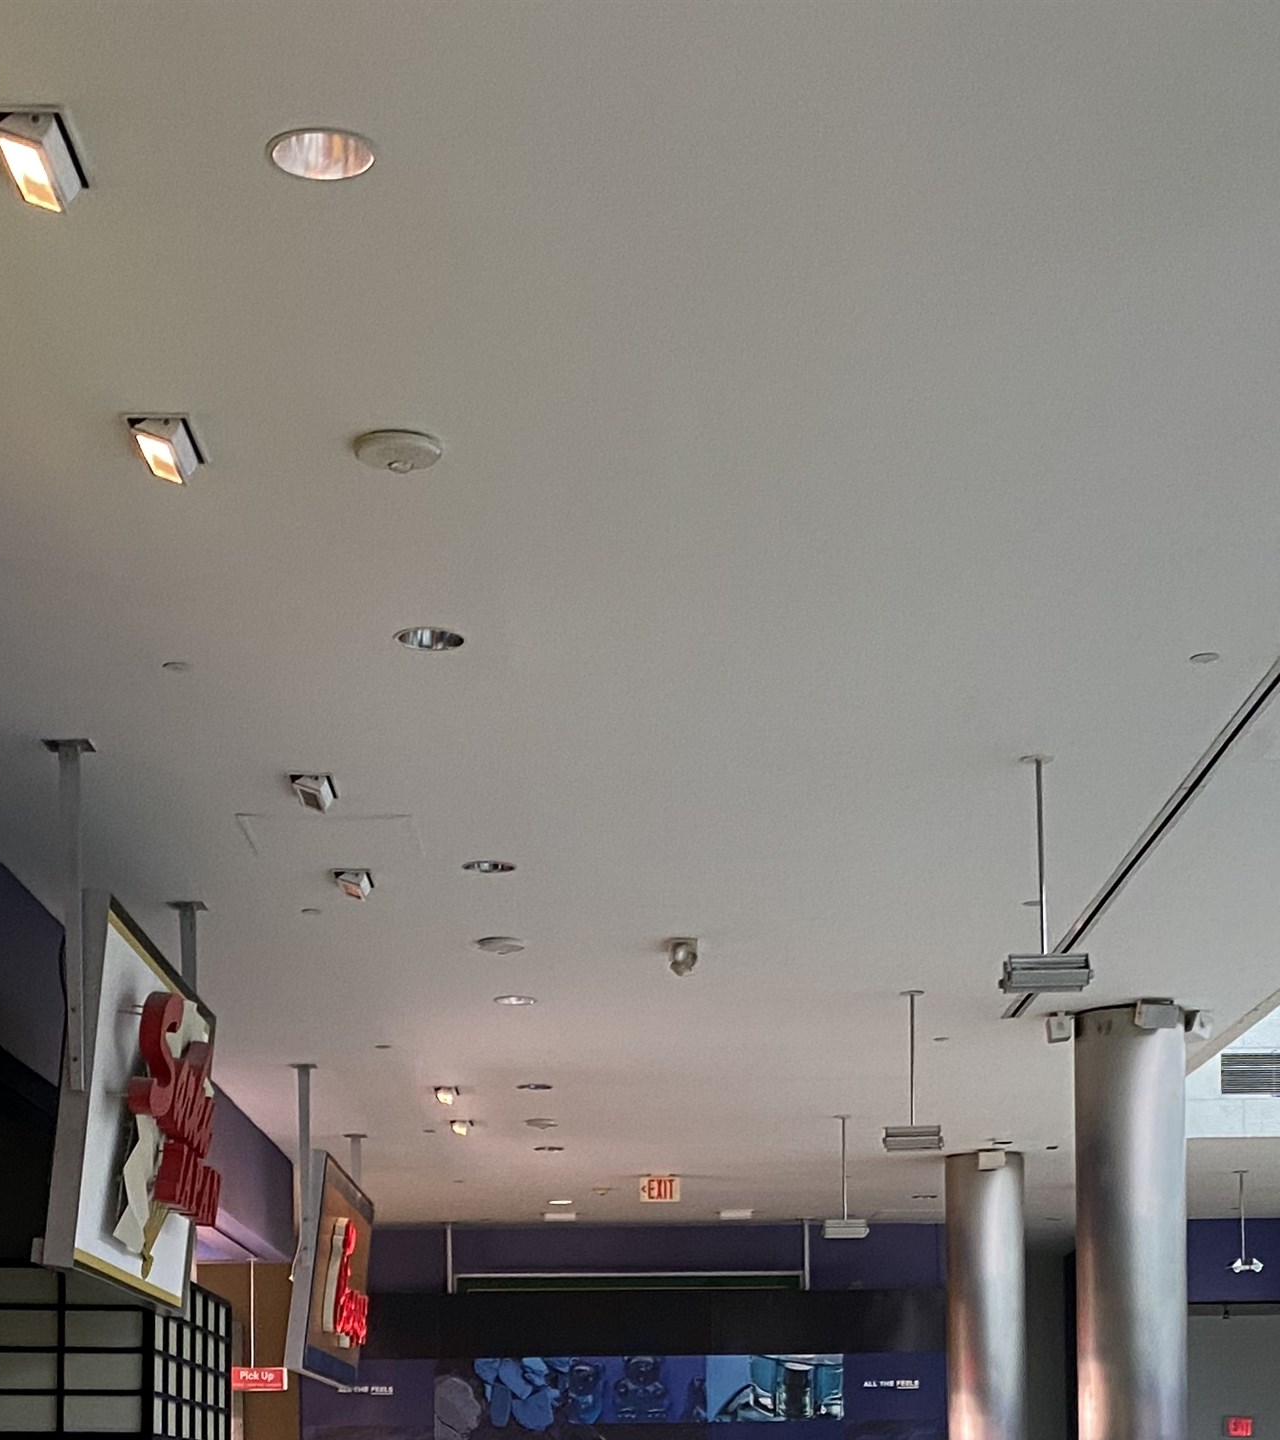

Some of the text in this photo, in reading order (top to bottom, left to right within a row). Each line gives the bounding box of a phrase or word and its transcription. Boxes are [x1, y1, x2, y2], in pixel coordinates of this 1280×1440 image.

[648, 1179, 675, 1200] EXIT
[239, 1370, 275, 1383] Pick Up
[863, 1379, 920, 1389] ALL THE FEELS
[370, 1385, 394, 1395] FEELS
